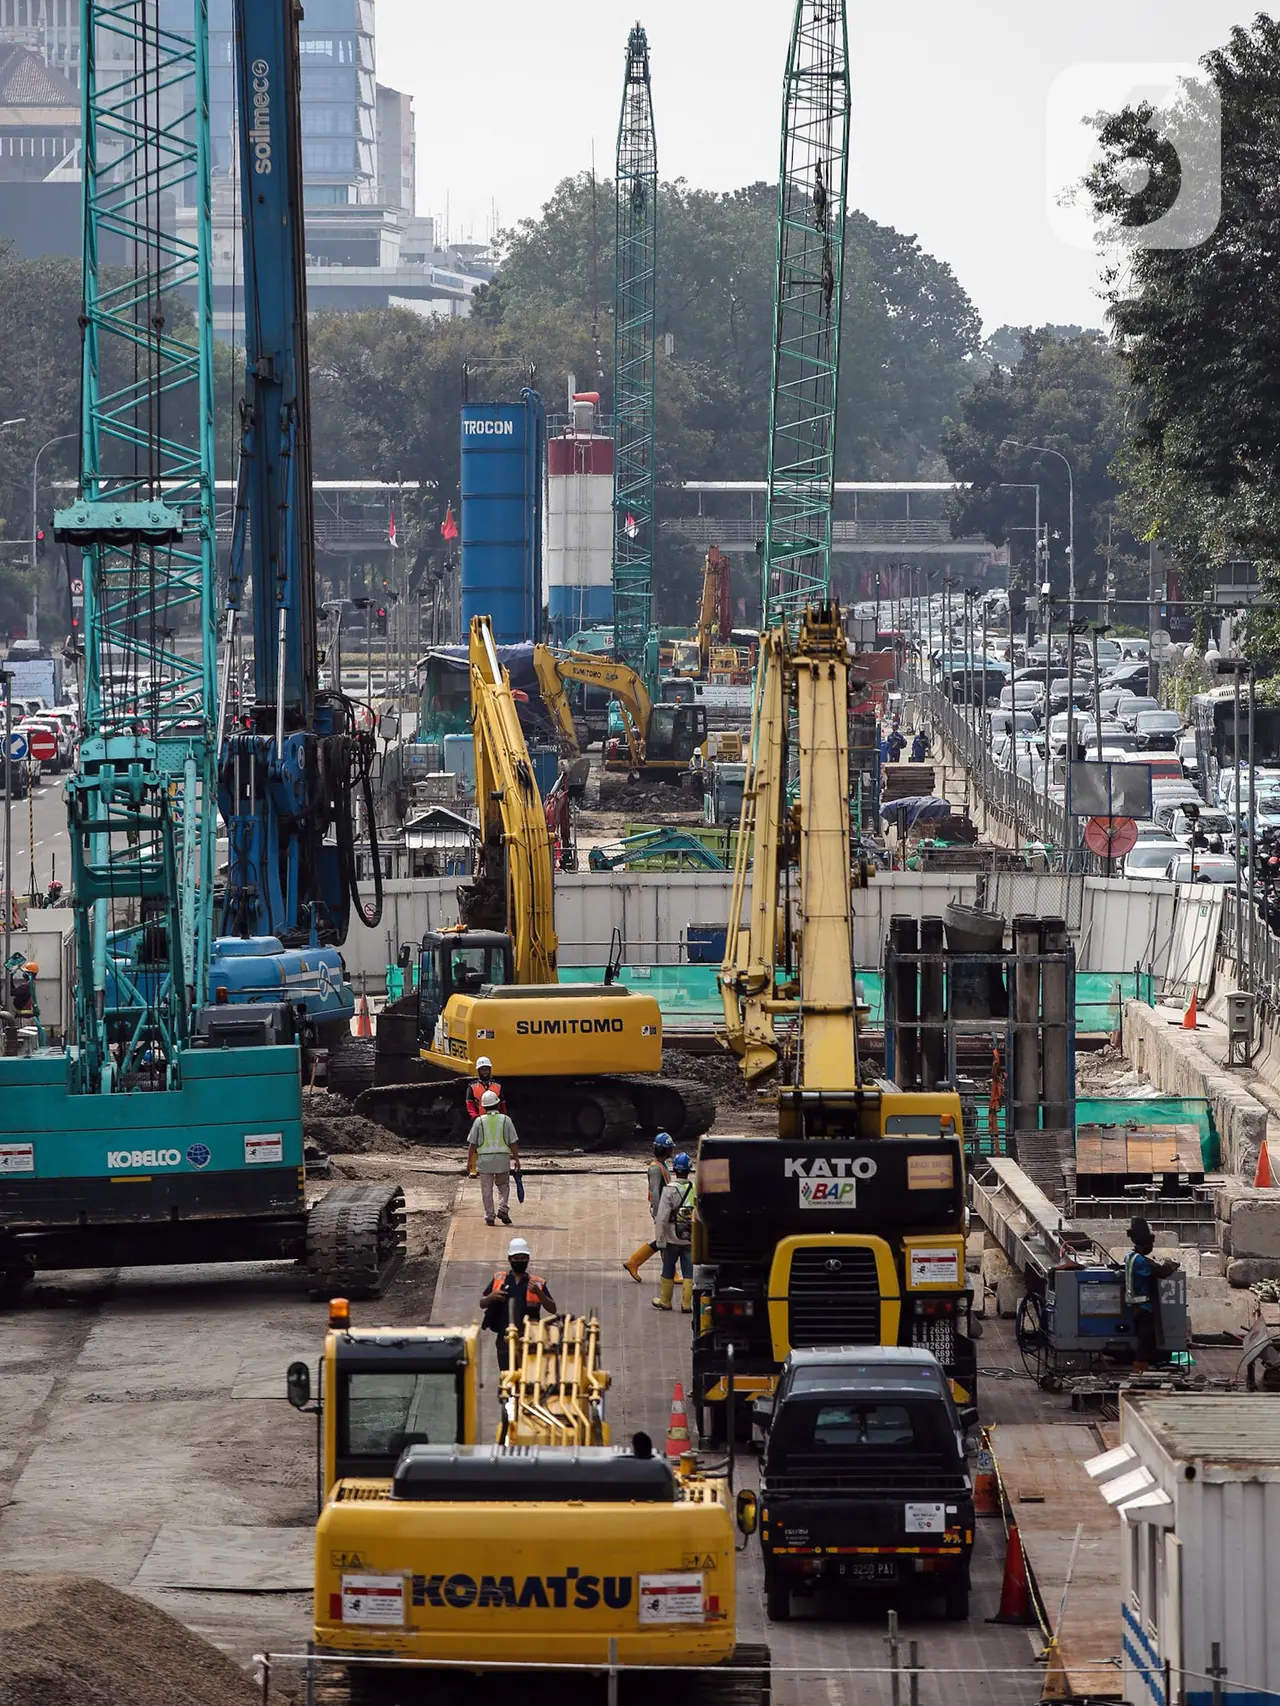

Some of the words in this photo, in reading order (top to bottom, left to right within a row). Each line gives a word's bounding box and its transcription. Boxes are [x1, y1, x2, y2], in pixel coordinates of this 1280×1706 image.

[249, 77, 272, 175] soilmec
[516, 1018, 624, 1035] SUMITOMO
[107, 1149, 181, 1168] KOBELCO
[784, 1157, 877, 1179] KATO
[812, 1183, 854, 1200] BAP
[1160, 1280, 1184, 1305] 21
[412, 1567, 632, 1609] KOMATSU
